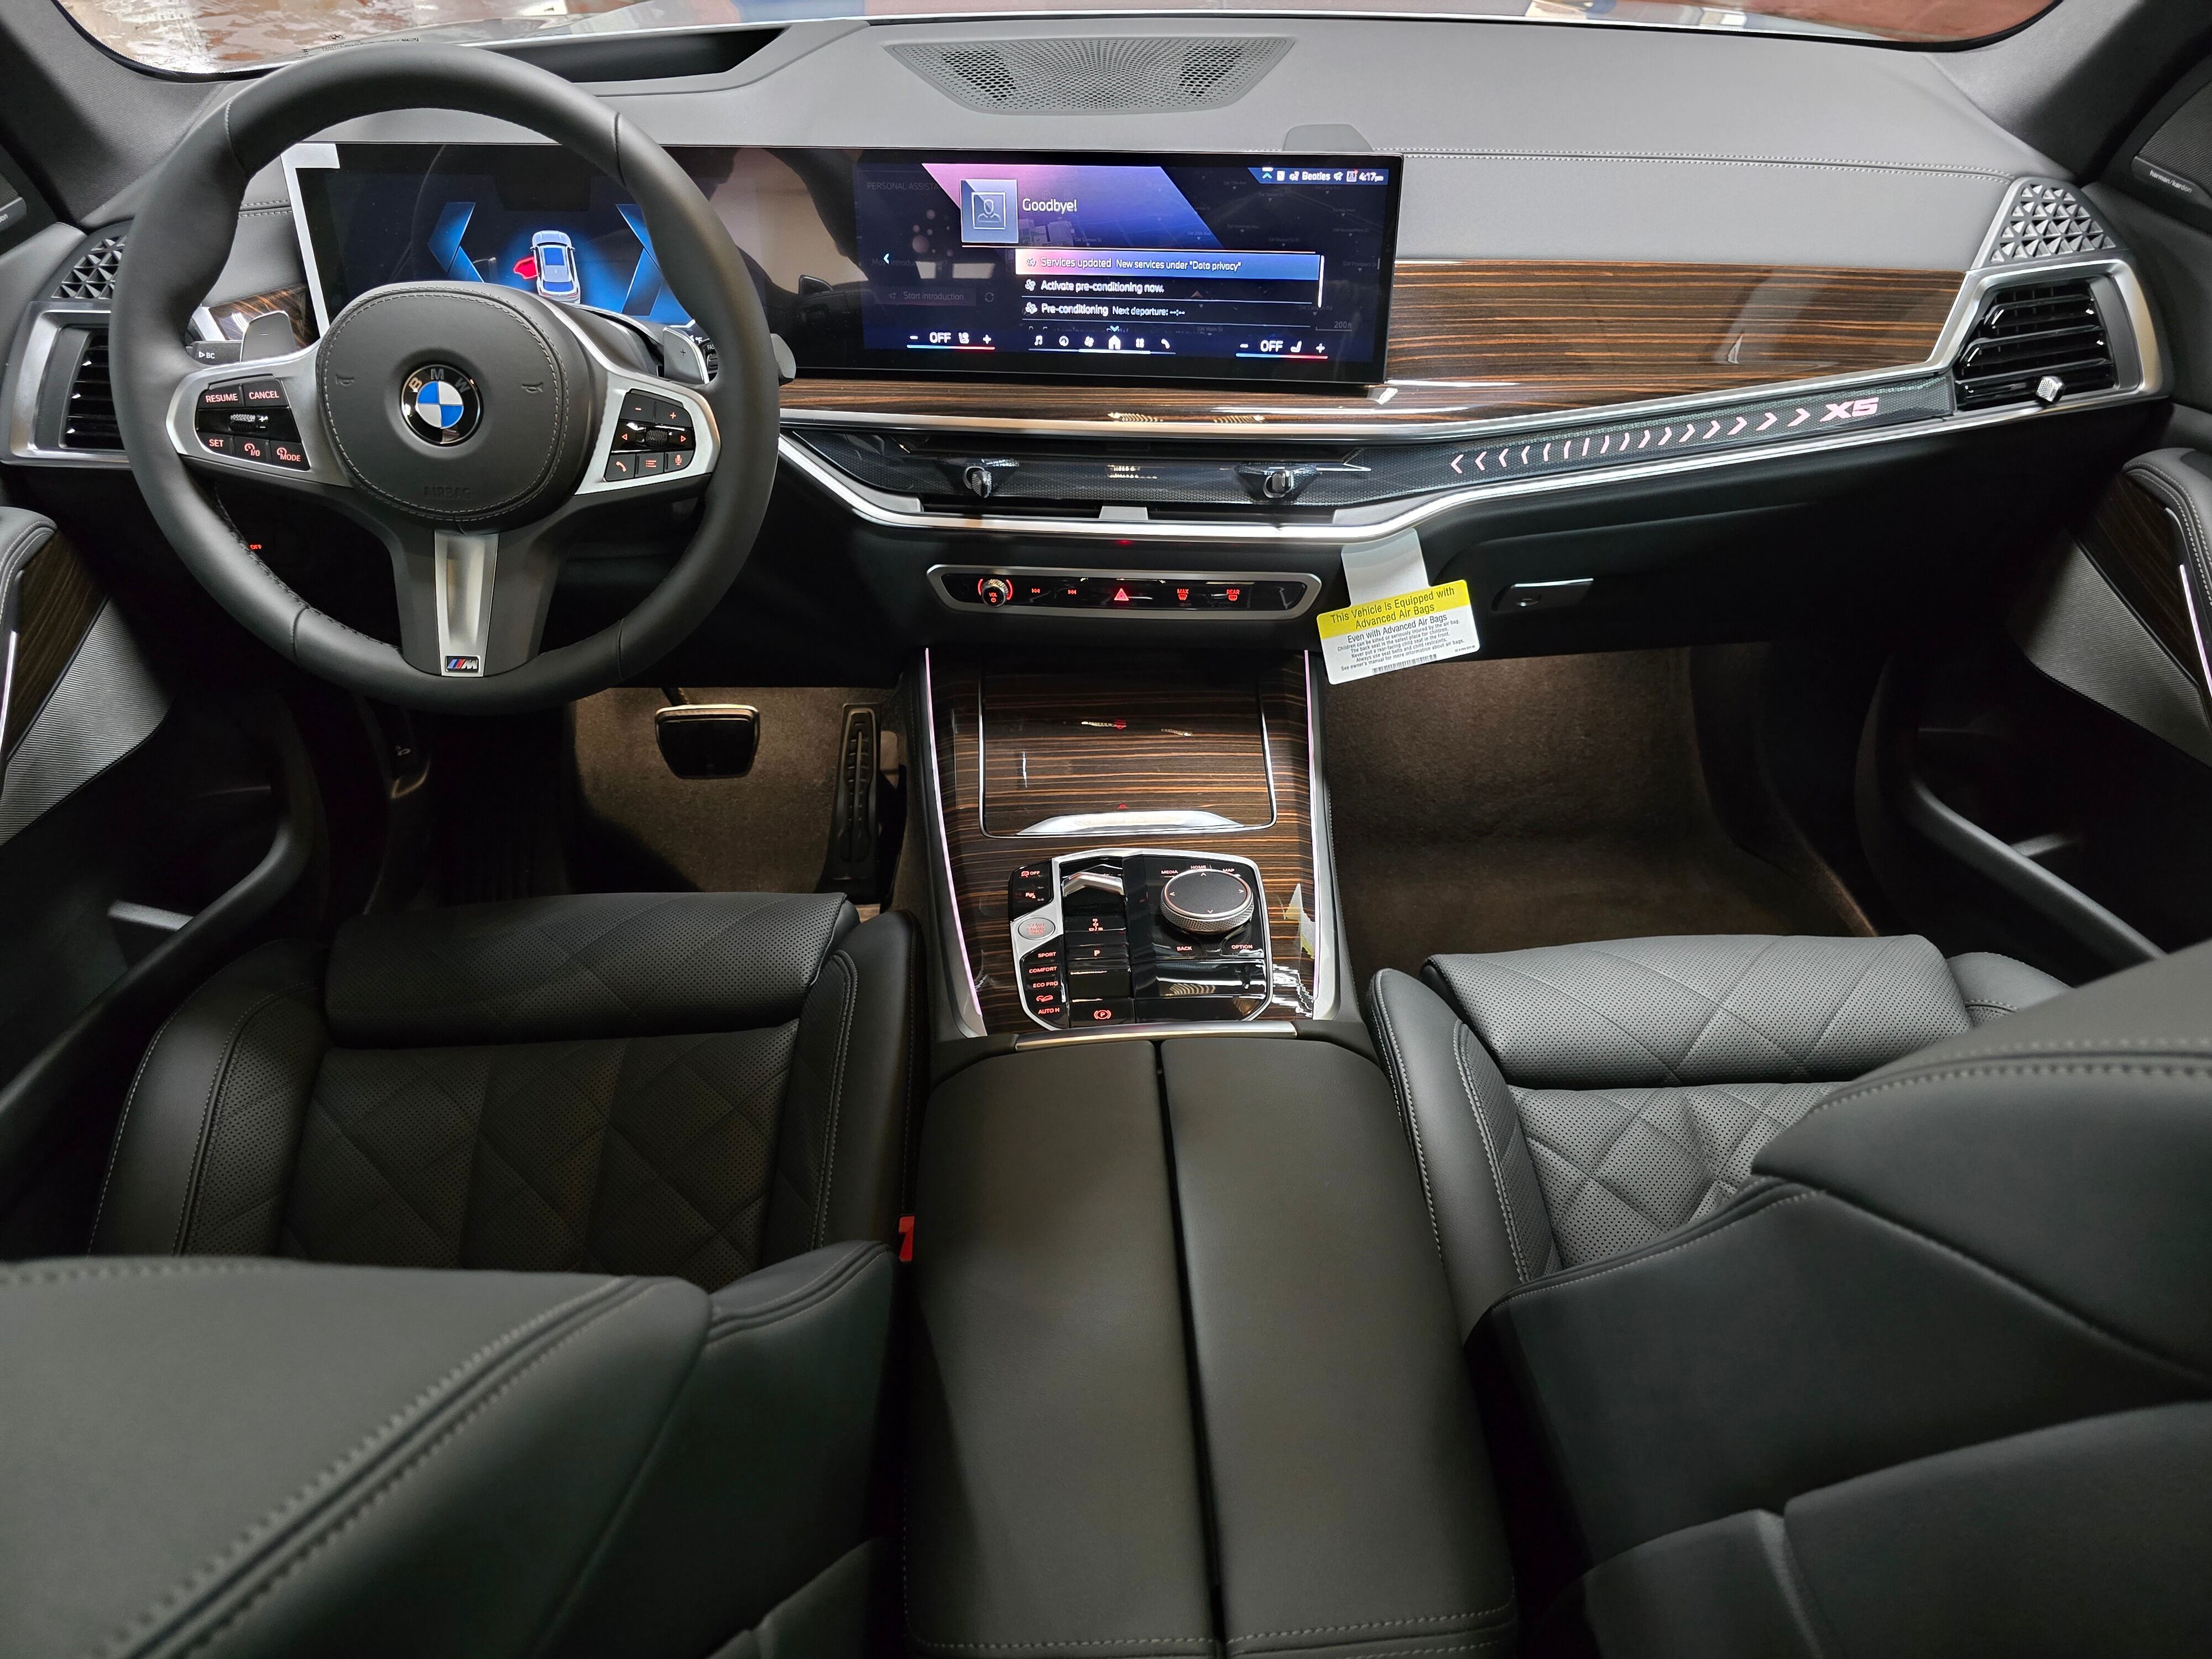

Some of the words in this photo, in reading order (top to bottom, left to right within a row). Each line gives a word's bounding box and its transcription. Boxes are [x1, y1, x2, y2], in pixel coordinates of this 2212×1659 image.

[867, 182, 907, 190] PERSONAL
[1022, 199, 1077, 214] Goodbye!
[1041, 257, 1075, 267] Services
[1078, 258, 1112, 269] updated
[1116, 259, 1133, 268] New
[1134, 259, 1165, 269] services
[1166, 260, 1188, 269] under
[1041, 280, 1074, 291] Activate
[1076, 281, 1143, 294] pre-conditioning
[1144, 284, 1165, 293] now.
[903, 291, 920, 300] Start
[922, 292, 964, 301] introduction
[1041, 302, 1109, 317] Pre-conditioning
[1112, 305, 1130, 315] Next
[1131, 306, 1168, 317] departure:
[929, 332, 952, 343] OFF
[1260, 340, 1284, 352] OFF
[408, 368, 470, 393] BMW
[206, 393, 238, 403] RESUME
[249, 390, 279, 399] CANCEL
[1819, 397, 1880, 422] X5
[209, 439, 224, 447] SET
[280, 453, 301, 462] MODE
[1331, 612, 1349, 623] This
[1351, 604, 1382, 618] Vehicle
[1394, 592, 1434, 609] Equipped
[1436, 587, 1454, 598] with
[1354, 612, 1396, 629] Advanced
[1398, 608, 1411, 619] Air
[1413, 603, 1435, 617] Bags
[1347, 633, 1364, 643] Even
[1365, 629, 1380, 638] with
[1381, 620, 1416, 634] Advanced
[1417, 617, 1428, 626] Air
[1429, 613, 1447, 624] Bags
